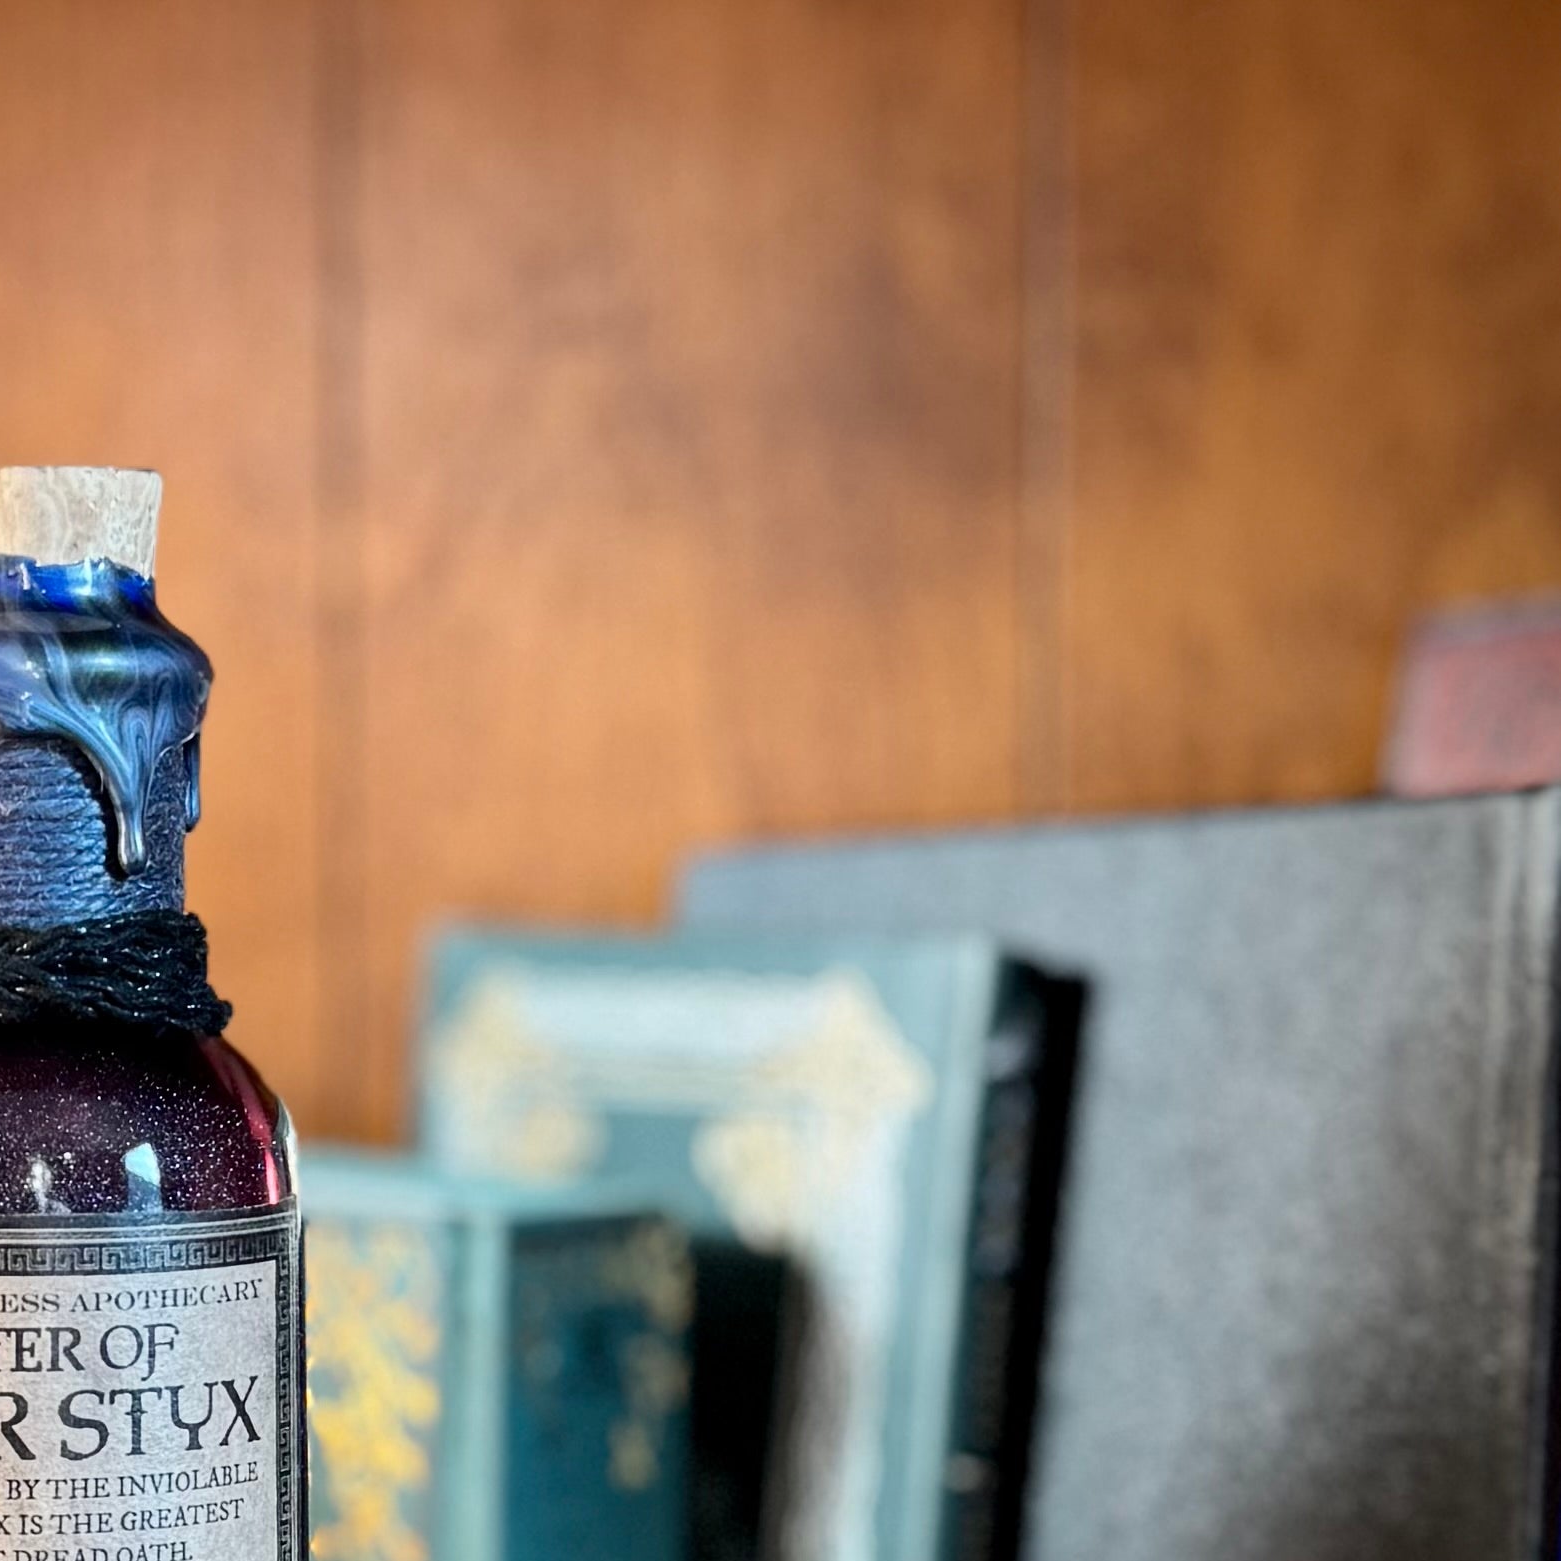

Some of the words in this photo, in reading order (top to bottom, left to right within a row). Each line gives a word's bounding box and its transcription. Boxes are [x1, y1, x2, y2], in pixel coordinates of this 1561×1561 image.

[70, 1278, 263, 1313] APOTHECARY
[99, 1322, 180, 1382] OF
[59, 1375, 262, 1461] STYX
[7, 1478, 40, 1500] BY
[46, 1477, 110, 1499] THE
[117, 1461, 259, 1497] INVIOLABLE
[19, 1514, 43, 1535] IS
[50, 1512, 114, 1535] THE
[120, 1498, 245, 1531] GREATEST
